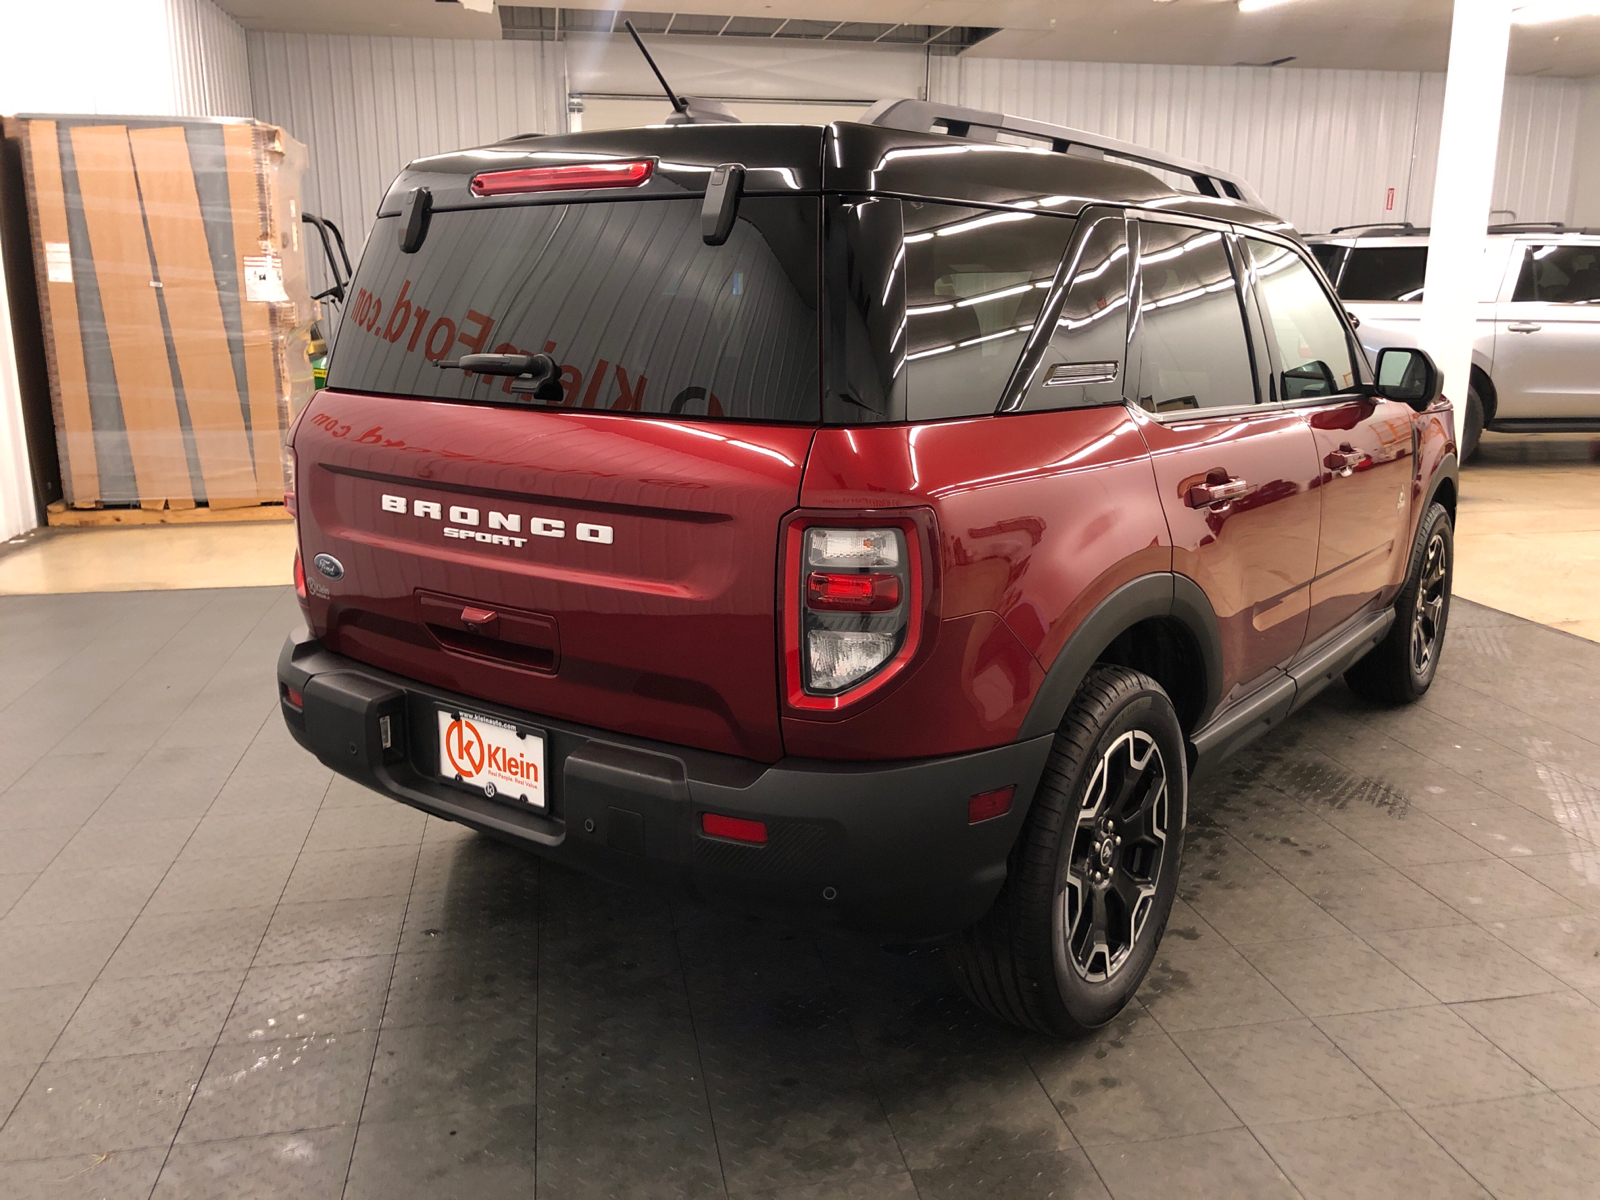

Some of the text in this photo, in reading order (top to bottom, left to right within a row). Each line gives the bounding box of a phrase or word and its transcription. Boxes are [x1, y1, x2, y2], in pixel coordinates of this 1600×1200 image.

[381, 493, 614, 545] BRONCO
[443, 526, 528, 548] SPORT
[459, 711, 517, 731] www.kleinauto.com
[487, 743, 539, 783] Klein
[488, 769, 498, 778] Real
[498, 771, 514, 783] People.
[514, 777, 525, 786] Real
